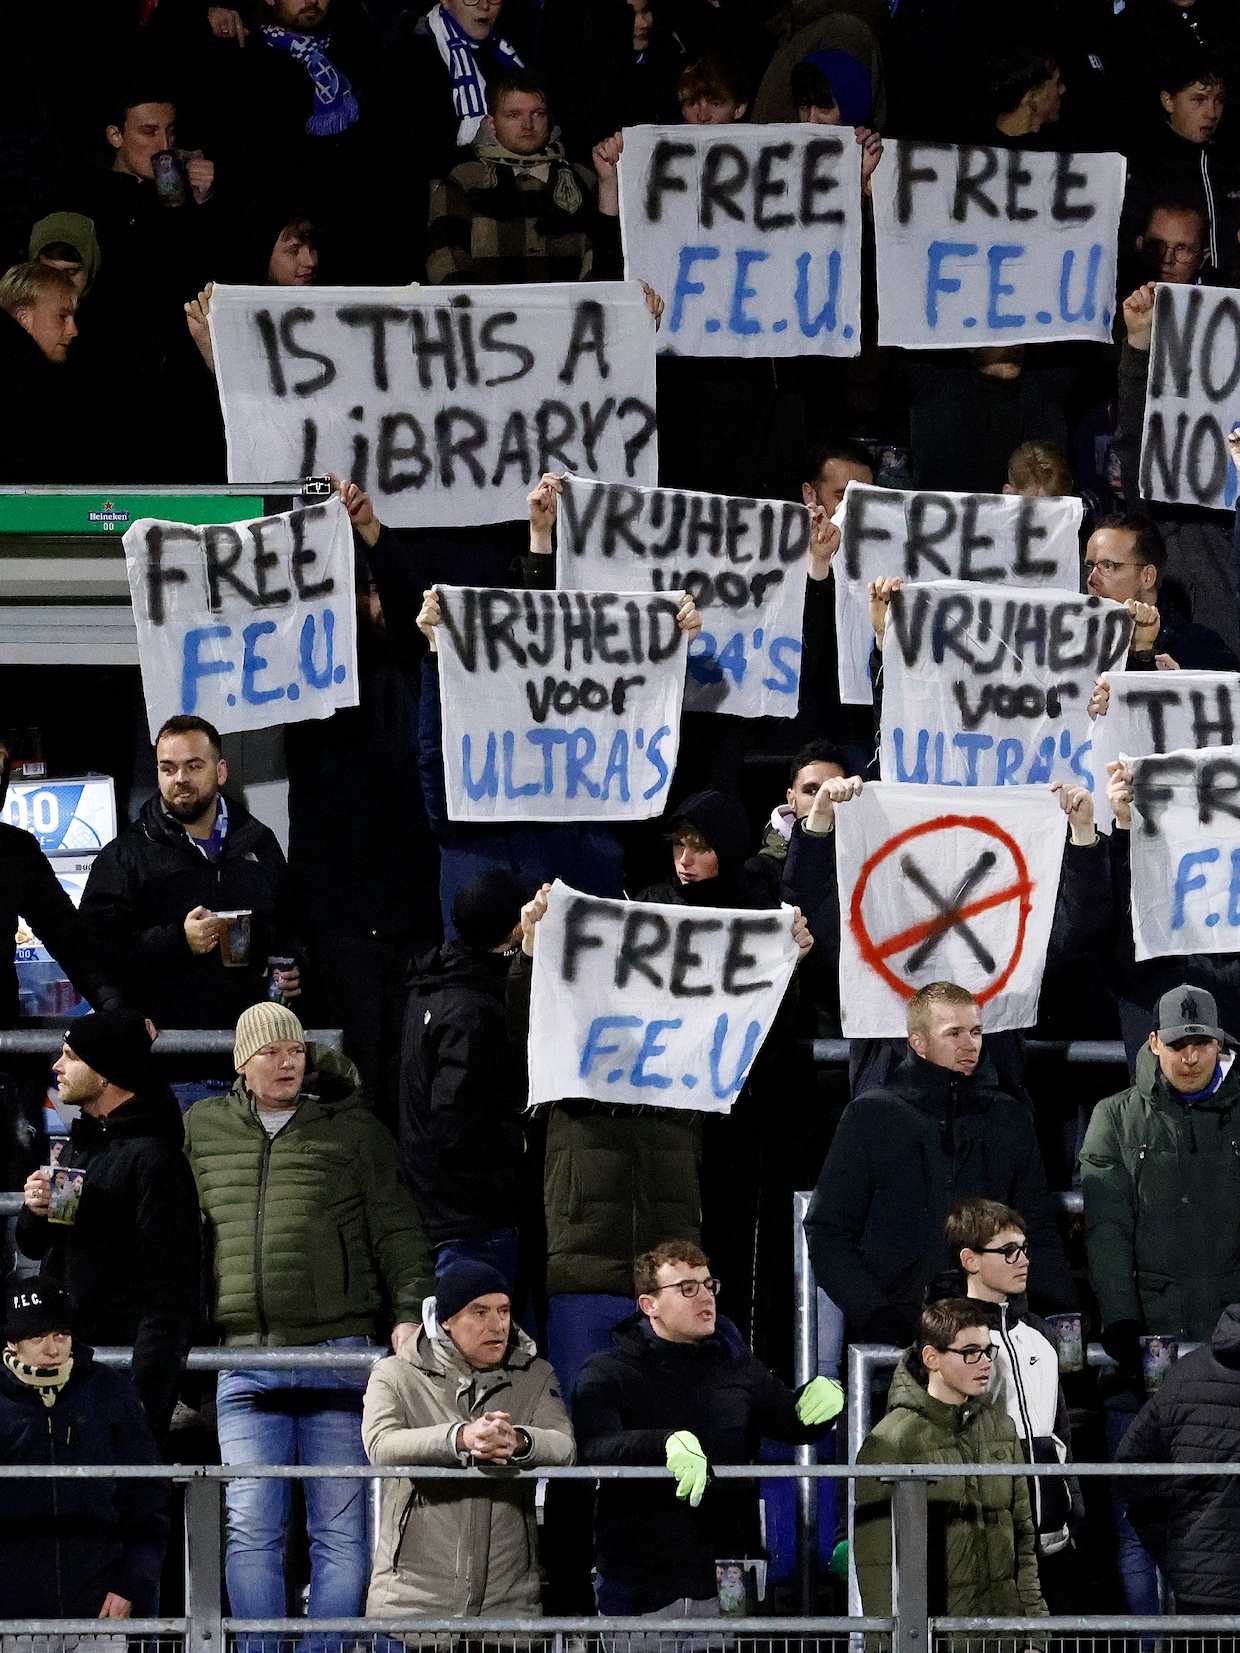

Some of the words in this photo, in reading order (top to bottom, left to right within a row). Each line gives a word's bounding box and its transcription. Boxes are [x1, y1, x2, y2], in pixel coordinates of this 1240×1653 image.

[645, 138, 845, 231] FREE
[897, 140, 1096, 223] FREE
[669, 247, 854, 338] F.E.U.
[926, 241, 1110, 330] F.E.U.
[255, 306, 336, 397] IS
[559, 300, 609, 384] A
[1140, 411, 1228, 502] NO
[90, 512, 128, 521] Heineken
[561, 477, 810, 563] VRIJHEID
[845, 489, 1061, 580] FREE
[146, 506, 334, 626] FREE
[181, 609, 345, 715] F.E.U.
[438, 588, 682, 672] VRIJHEID
[527, 675, 645, 723] voor
[955, 680, 1079, 729] voor
[462, 726, 671, 801] ULTRA'S
[893, 727, 1095, 792] ULTRA'S
[561, 896, 783, 997] FREE
